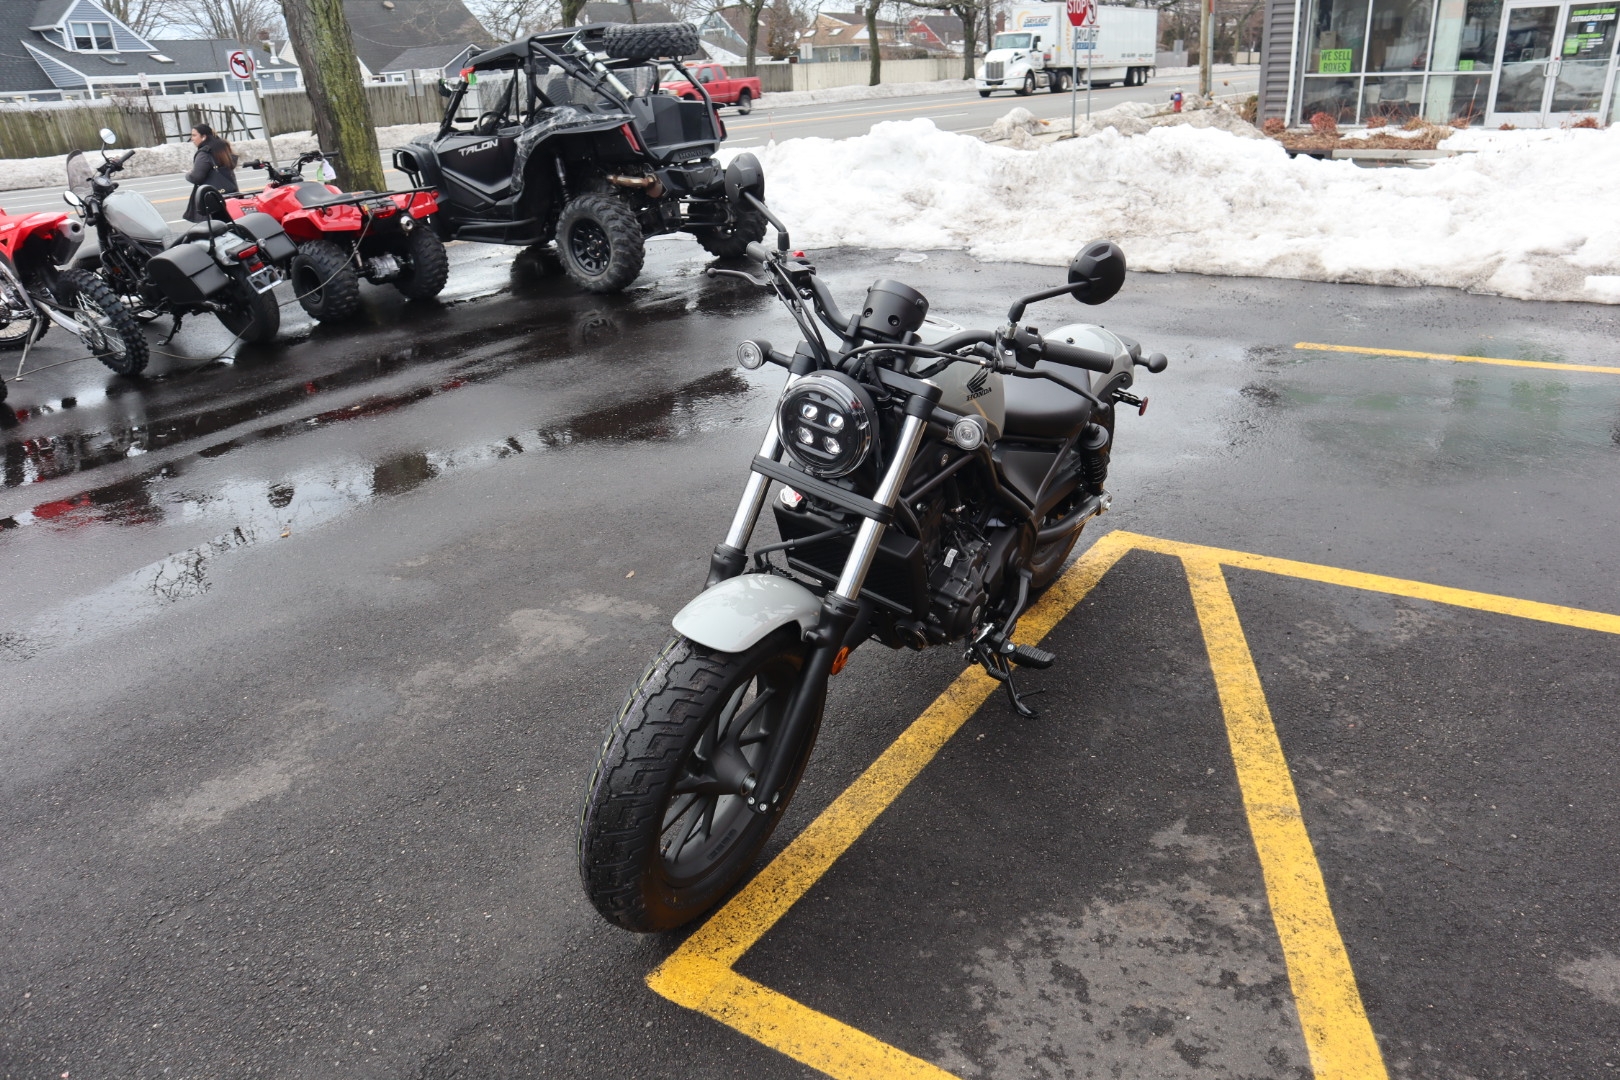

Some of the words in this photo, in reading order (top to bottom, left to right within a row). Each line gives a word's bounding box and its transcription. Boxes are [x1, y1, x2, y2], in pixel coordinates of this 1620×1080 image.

[1068, 0, 1086, 14] STOP
[1321, 51, 1332, 61] WE
[1333, 50, 1351, 61] SELL
[1323, 62, 1347, 72] BOXES
[458, 139, 498, 157] TALON
[966, 387, 992, 401] HONDA
